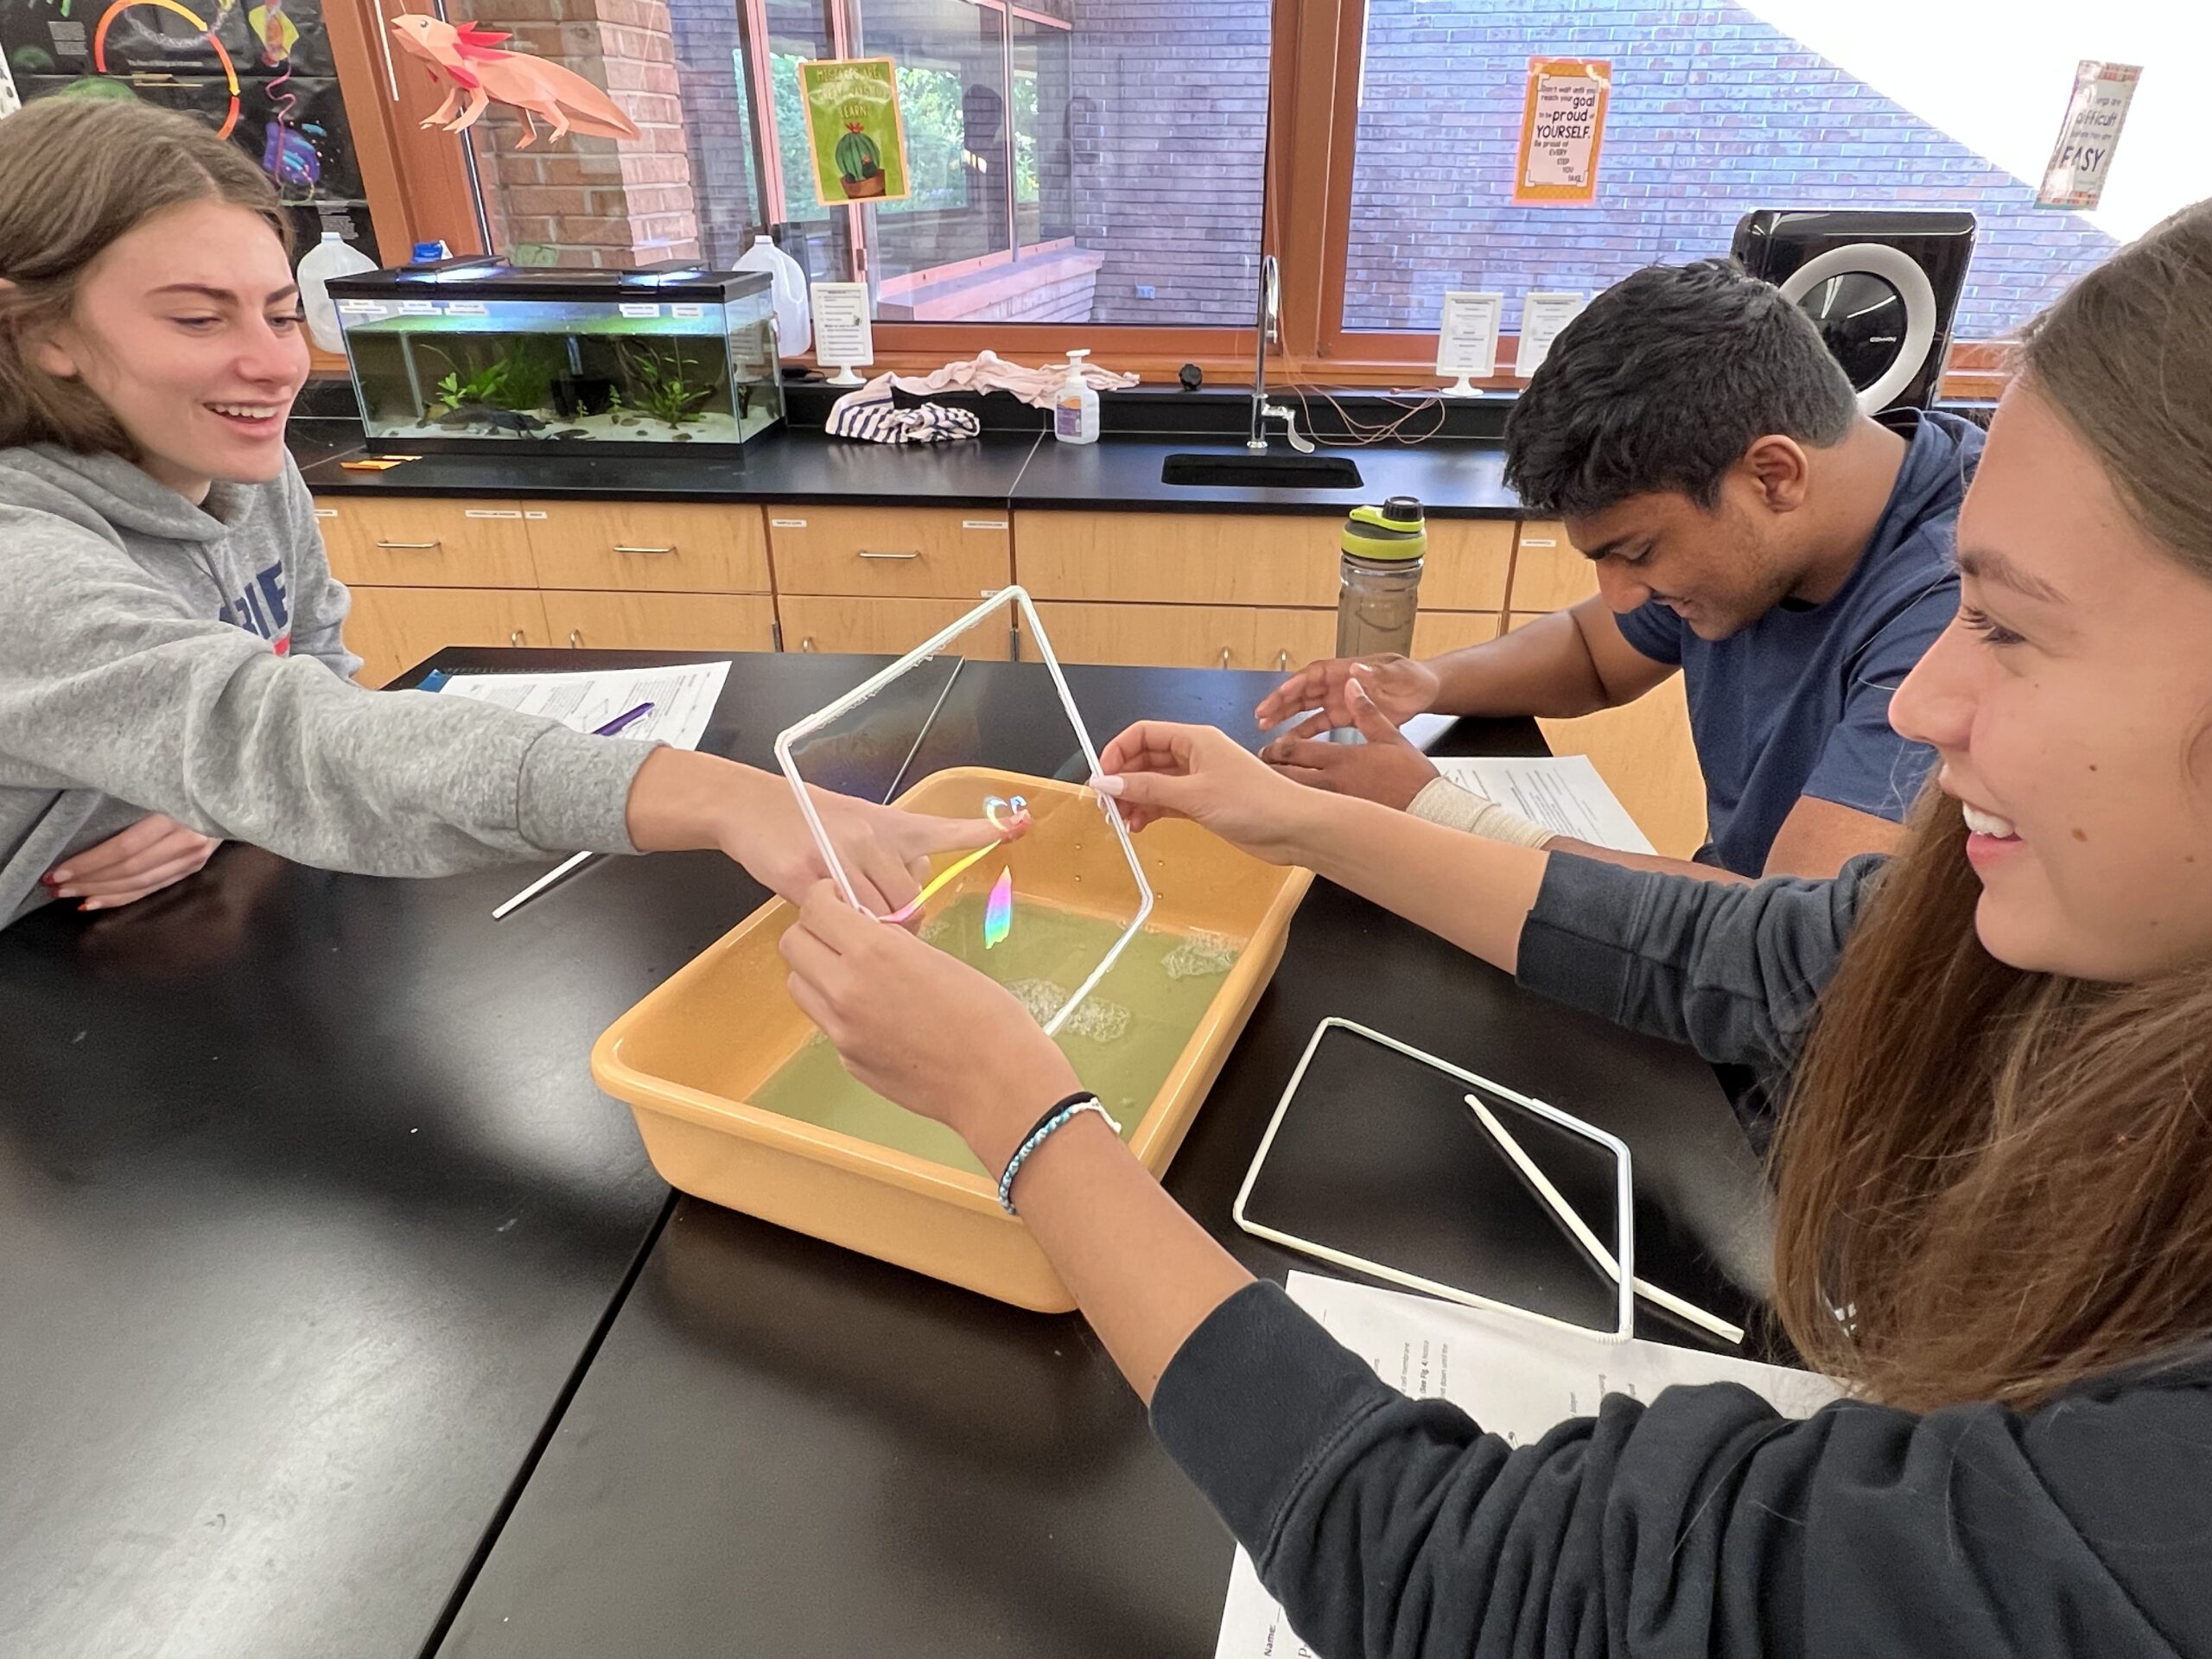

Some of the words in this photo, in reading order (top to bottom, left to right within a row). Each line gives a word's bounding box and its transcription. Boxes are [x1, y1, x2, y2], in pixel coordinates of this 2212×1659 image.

[1573, 95, 1596, 110] goal
[1552, 109, 1588, 124] proud
[1536, 125, 1591, 139] YOURSELF.
[2059, 145, 2105, 173] EASY
